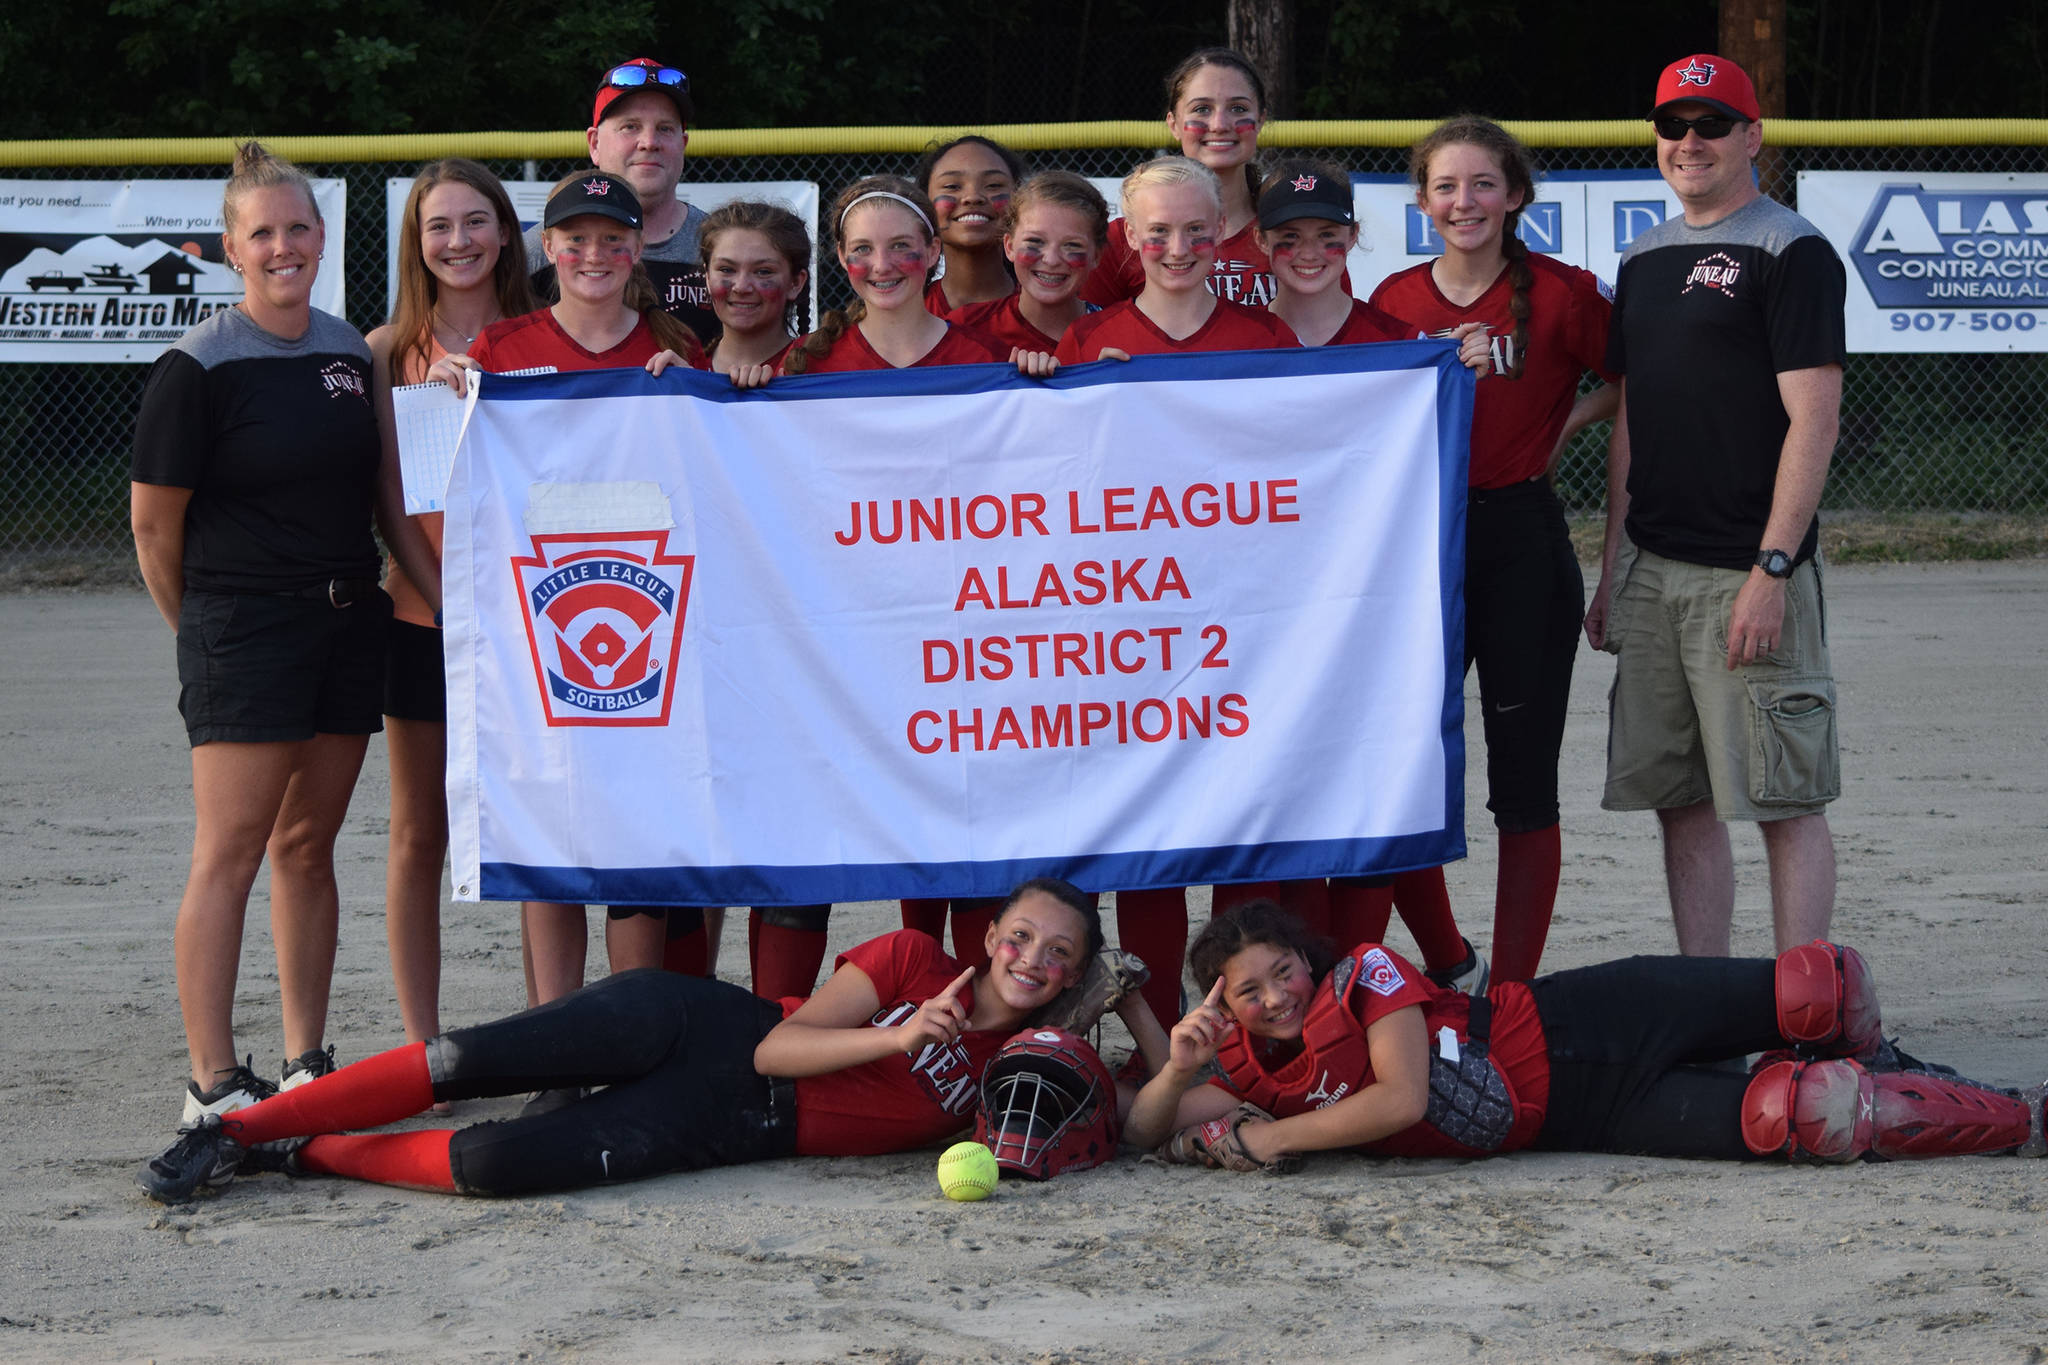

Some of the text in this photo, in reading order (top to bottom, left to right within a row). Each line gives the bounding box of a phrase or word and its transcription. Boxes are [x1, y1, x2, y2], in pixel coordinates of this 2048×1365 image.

[18, 197, 44, 208] you
[187, 217, 212, 229] you
[1686, 265, 1740, 286] JUNEAU
[101, 297, 168, 326] AUTO
[102, 329, 129, 338] HOME
[834, 478, 1301, 546] JUNIOR LEAGUE
[536, 563, 669, 602] LITTLE LEAGUE
[954, 556, 1192, 611] ALASKA
[922, 624, 1230, 683] DISTRICT 2
[566, 688, 648, 710] SOFTBALL
[906, 693, 1250, 755] CHAMPIONS
